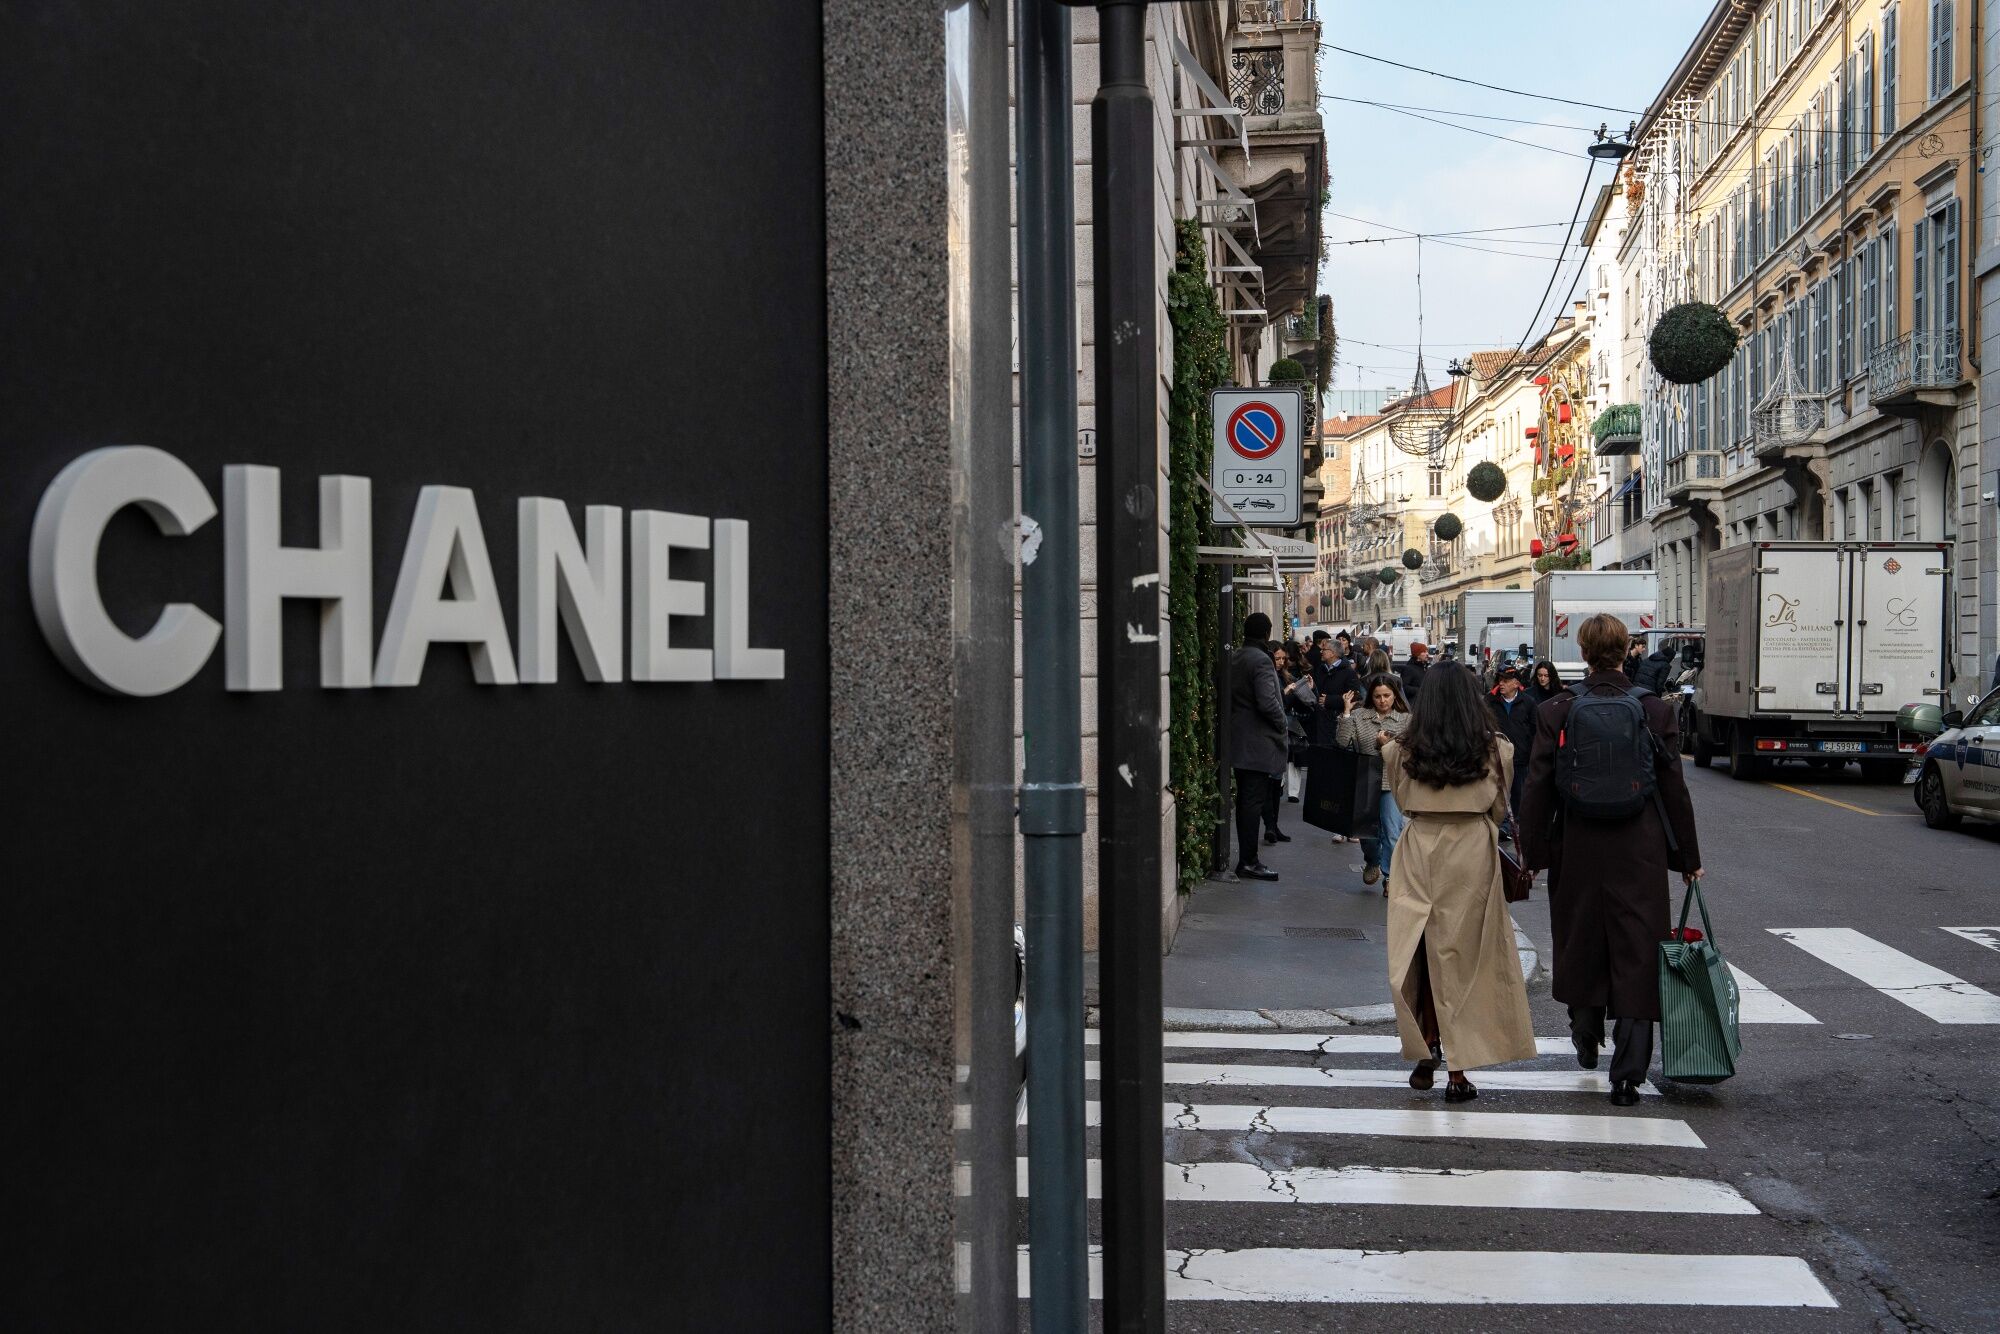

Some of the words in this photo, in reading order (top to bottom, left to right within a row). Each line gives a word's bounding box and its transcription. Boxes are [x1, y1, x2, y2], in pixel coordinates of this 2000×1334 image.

[1236, 474, 1244, 483] 0
[1256, 473, 1273, 483] 24
[29, 445, 785, 697] CHANEL
[1930, 670, 1935, 678] 6
